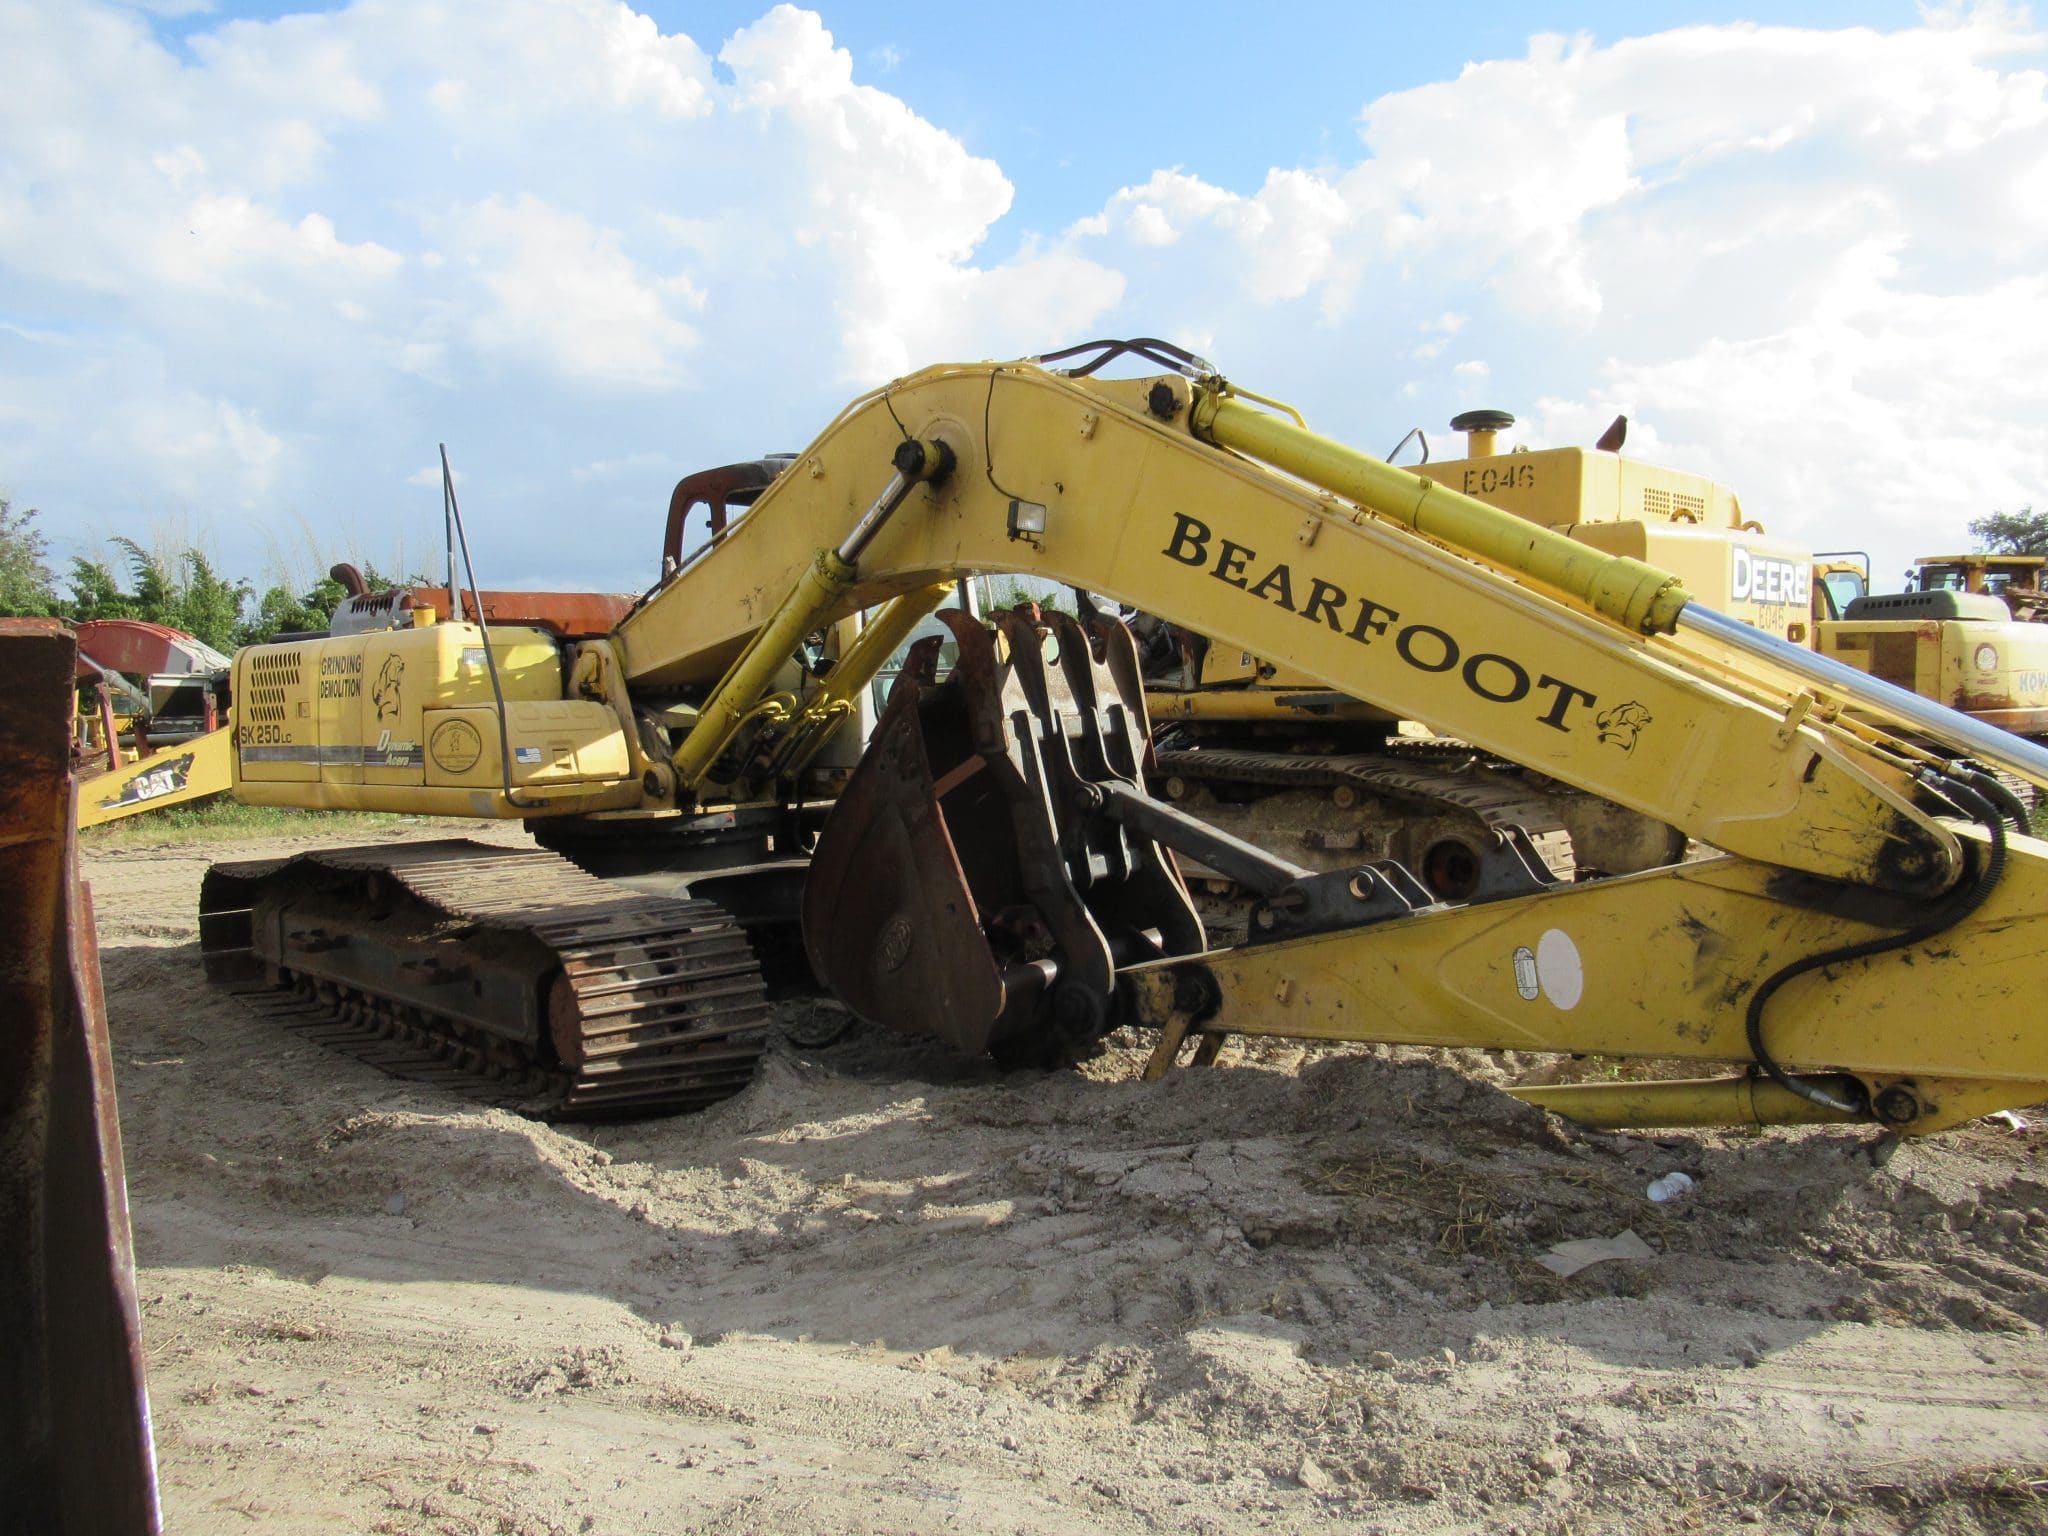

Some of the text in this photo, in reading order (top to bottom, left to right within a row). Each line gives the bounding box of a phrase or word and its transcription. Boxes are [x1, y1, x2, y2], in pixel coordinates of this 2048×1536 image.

[1464, 464, 1534, 494] E046
[1732, 545, 1809, 608] DEERE
[1161, 511, 1597, 733] BEARFOOT
[321, 655, 362, 676] GRINDING
[320, 679, 361, 698] DEMOLITION
[240, 725, 255, 744] SK
